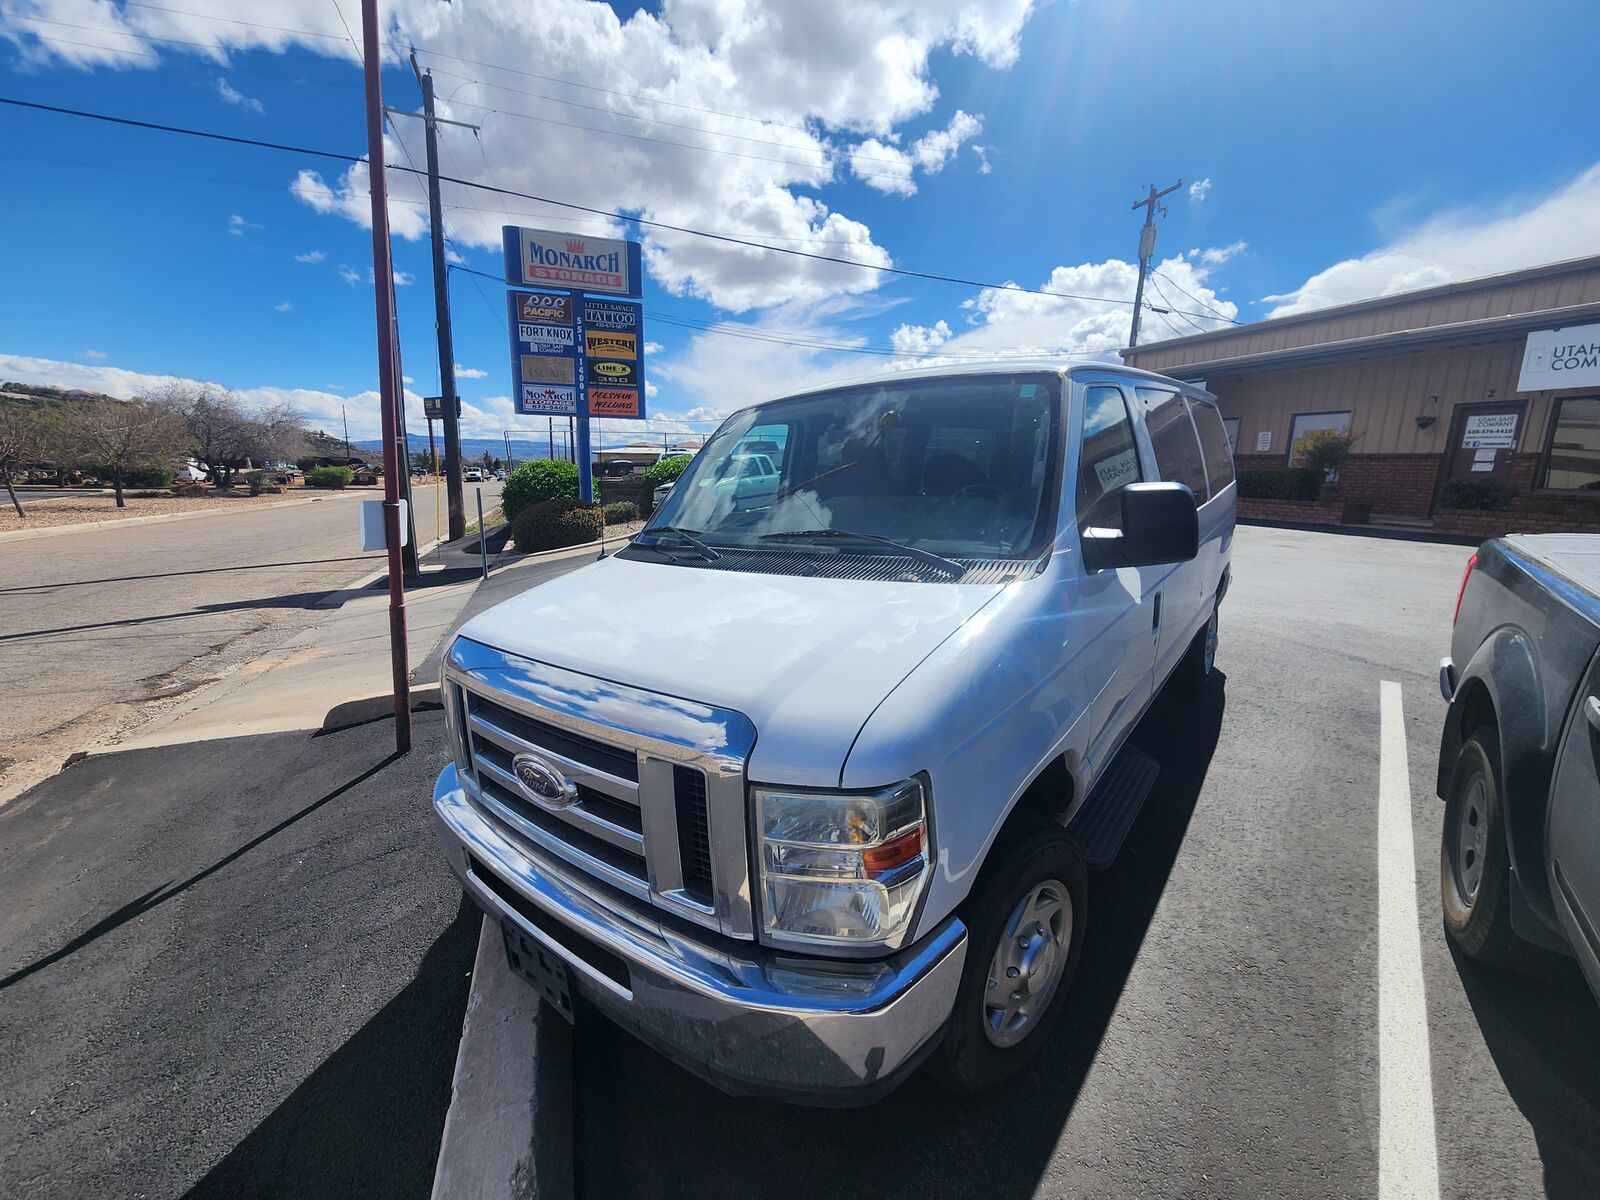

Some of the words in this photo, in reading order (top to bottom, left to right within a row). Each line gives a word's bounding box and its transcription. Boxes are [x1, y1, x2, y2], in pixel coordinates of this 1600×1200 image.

[530, 241, 619, 273] MONARCH
[535, 267, 617, 284] STORAGE
[524, 306, 564, 318] PACIFIC
[585, 302, 609, 310] LITTLE
[588, 311, 633, 324] TATTOO
[520, 326, 544, 336] FORT
[547, 328, 573, 341] KNOX
[587, 337, 635, 353] WESTERN
[1553, 343, 1600, 358] UTAH
[526, 389, 573, 401] MONARCH
[594, 401, 633, 409] WELDING
[523, 768, 548, 794] Ford
